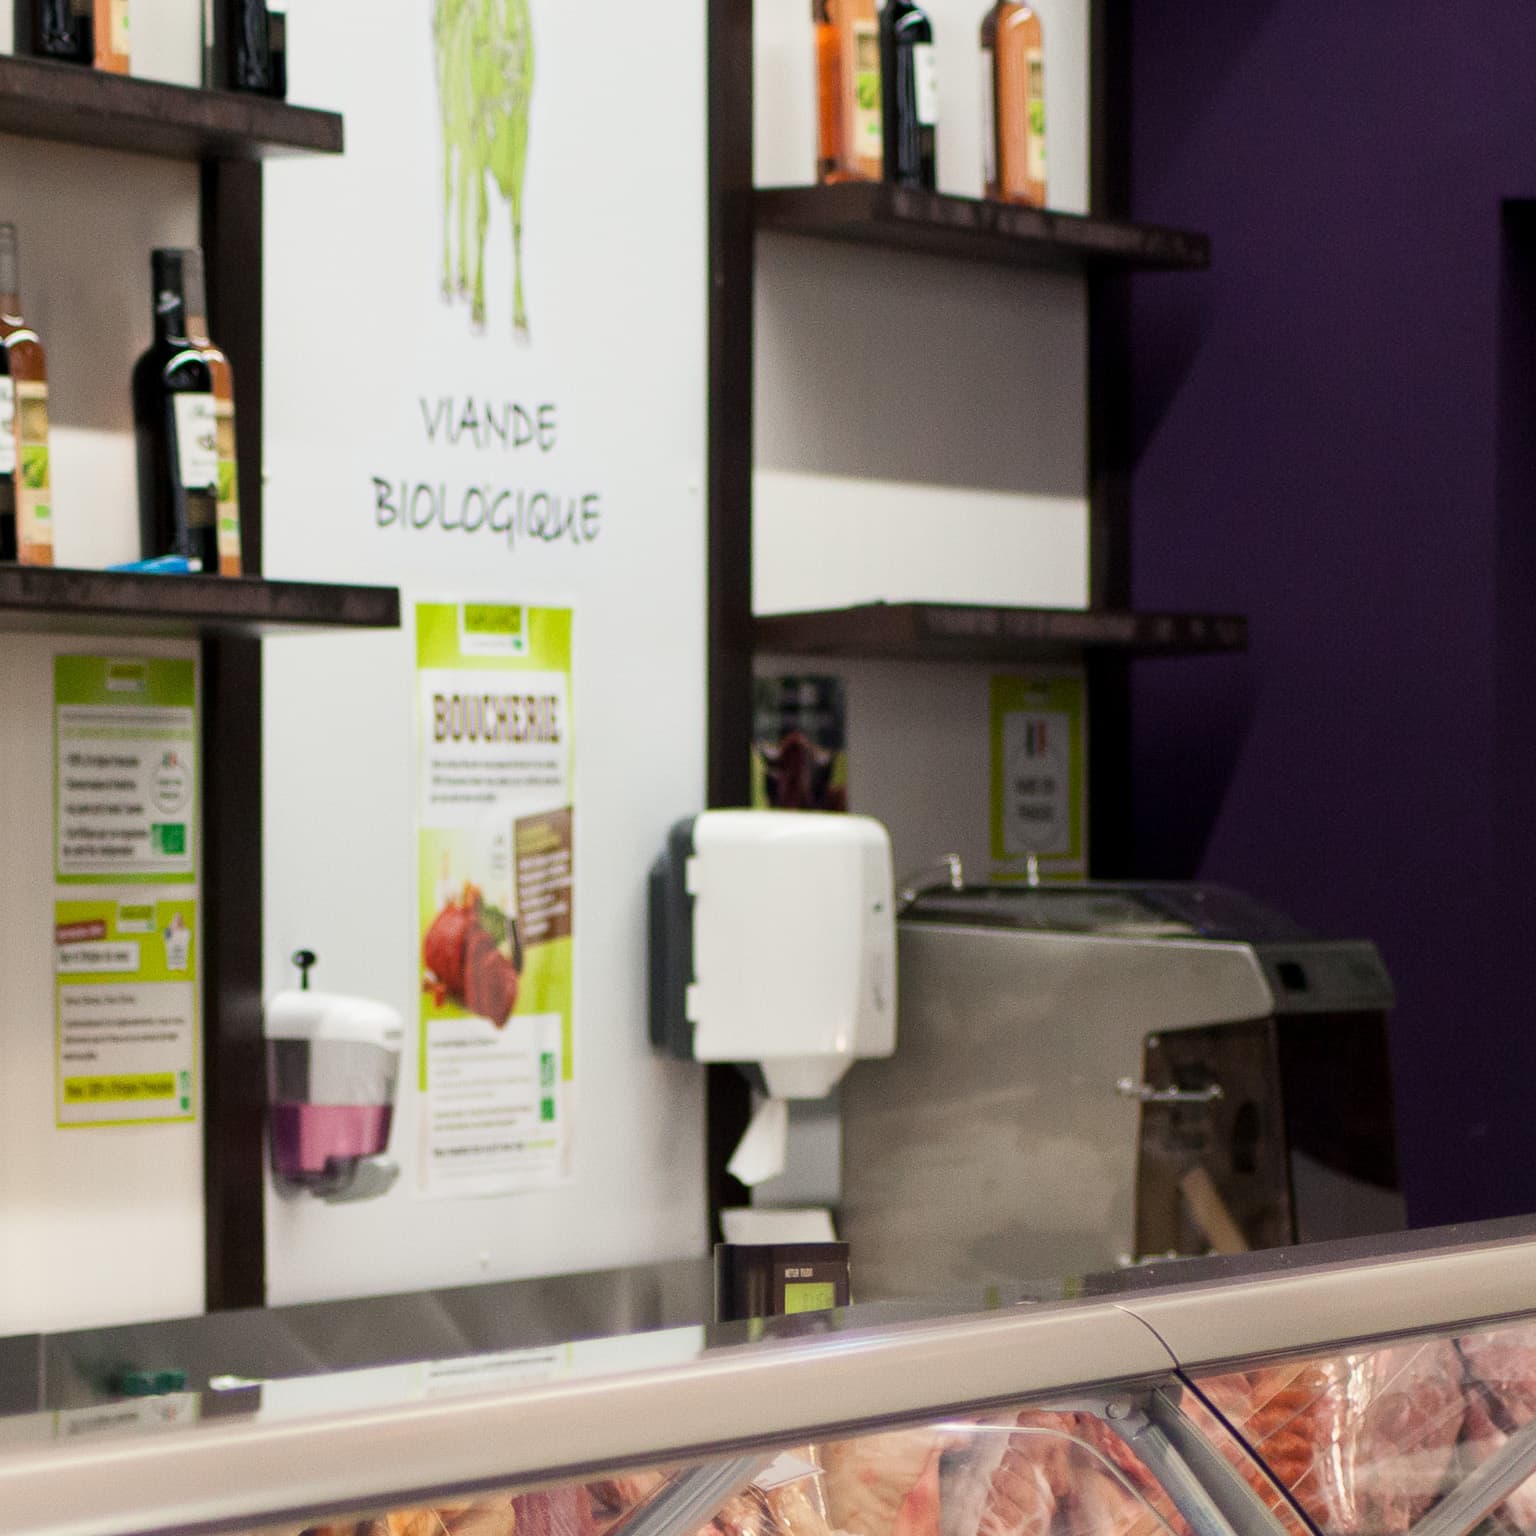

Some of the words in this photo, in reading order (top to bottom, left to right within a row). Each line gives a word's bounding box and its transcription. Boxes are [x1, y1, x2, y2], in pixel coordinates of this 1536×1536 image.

[419, 395, 557, 453] VIANDE
[370, 476, 602, 551] BIOLOGIQUE
[432, 694, 561, 743] BOUCHERIE
